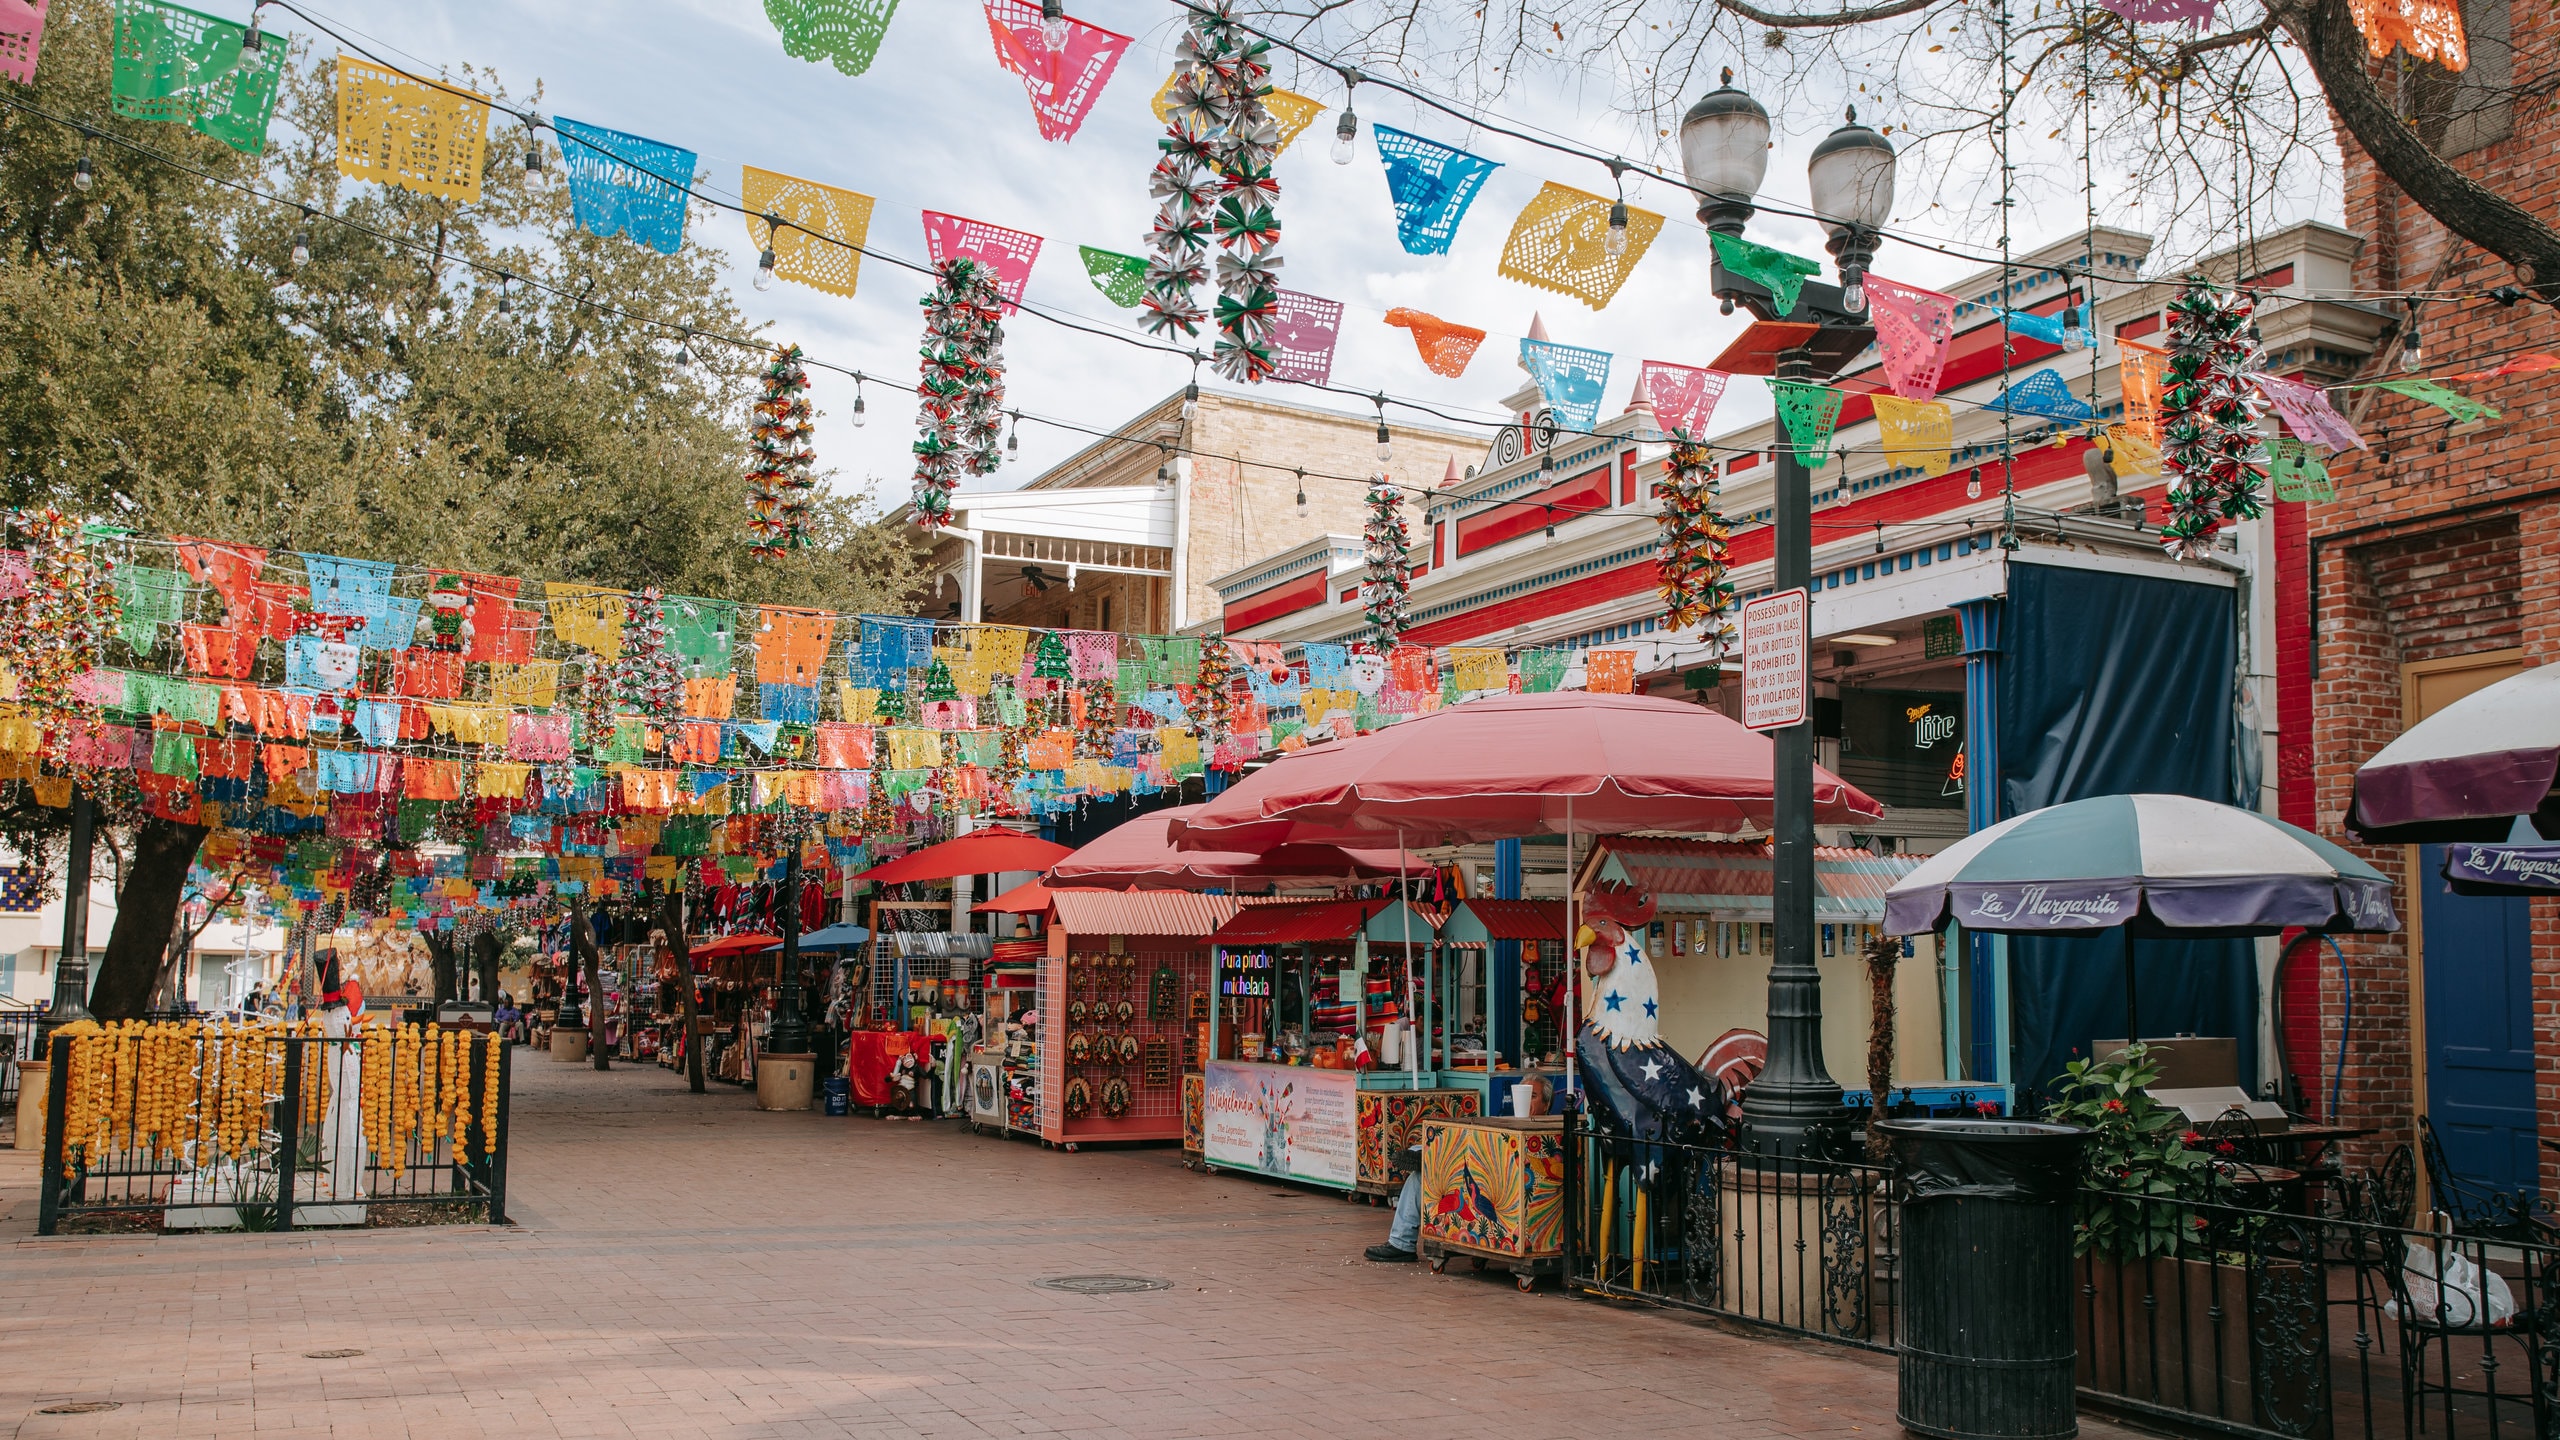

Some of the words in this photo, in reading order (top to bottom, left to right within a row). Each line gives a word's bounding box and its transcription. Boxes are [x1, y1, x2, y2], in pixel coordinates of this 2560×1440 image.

[1748, 604, 1788, 623] POSSESSION
[1792, 600, 1800, 612] OF
[1748, 623, 1774, 640] BEVERAGES
[1776, 622, 1782, 633] IN
[1784, 618, 1800, 632] GLASS,
[1748, 644, 1760, 656] CAN,
[1762, 641, 1770, 653] OR
[1772, 637, 1792, 651] BOTTLES
[1795, 635, 1800, 646] IS
[1752, 653, 1796, 672] PROHIBITED
[1747, 676, 1758, 690] FINE
[1760, 676, 1767, 688] OF
[1769, 674, 1775, 686] $5
[1778, 672, 1784, 684] TO
[1787, 670, 1800, 683] $200
[1747, 695, 1760, 707] FOR
[1763, 687, 1800, 703] VIOLATORS
[1748, 710, 1757, 722] CITY
[1759, 707, 1784, 720] ORDINANCE
[1785, 704, 1799, 716] 59685
[1915, 715, 1955, 749] Lite
[2464, 846, 2490, 871] La
[2485, 850, 2560, 884] Margari
[1970, 891, 2009, 918] La
[2004, 885, 2120, 925] Margarita
[1221, 949, 1241, 968] Pura
[1242, 949, 1273, 973] pinche
[1224, 976, 1269, 996] michelada
[1226, 1125, 1246, 1137] Legendary
[1227, 1136, 1237, 1145] From
[1238, 1138, 1253, 1148] Mexico
